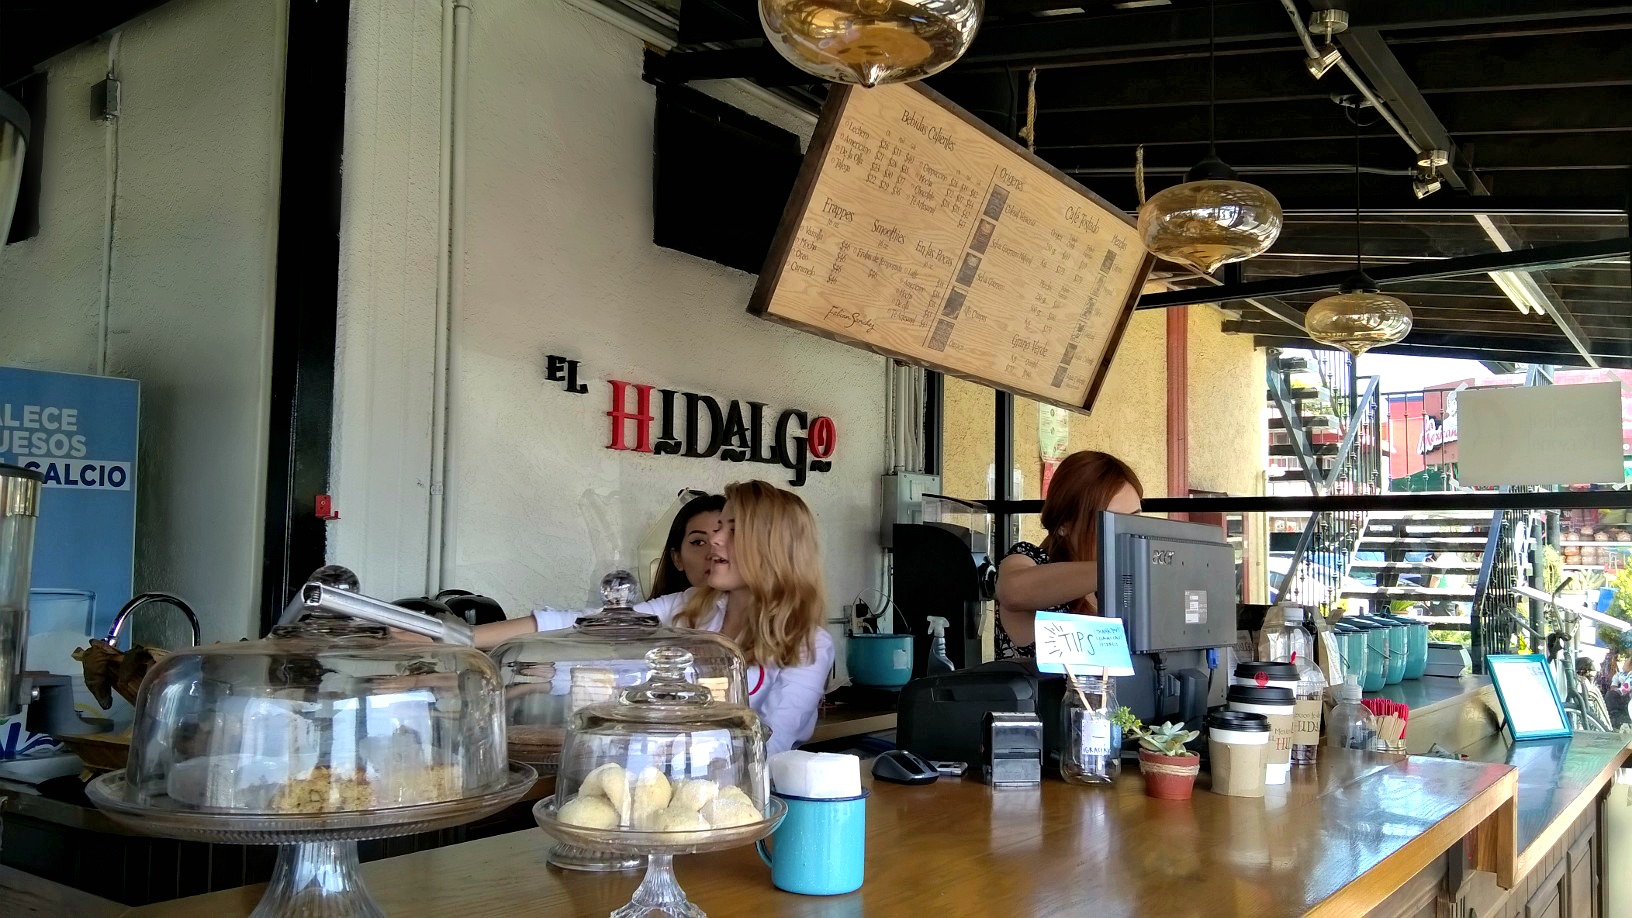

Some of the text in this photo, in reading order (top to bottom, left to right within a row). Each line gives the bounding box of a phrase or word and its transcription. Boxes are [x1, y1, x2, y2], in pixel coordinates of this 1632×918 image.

[901, 109, 956, 152] Bebidas Calientes
[845, 135, 872, 154] Americano
[822, 197, 855, 223] Frappes
[1064, 206, 1082, 225] Café
[871, 218, 907, 246] Smoothies
[915, 240, 926, 257] En
[924, 241, 935, 259] las
[545, 354, 589, 394] EL
[0, 404, 78, 431] LECE
[606, 379, 837, 487] HIDALGO
[1152, 549, 1175, 566] acer
[1058, 632, 1096, 656] TIPS
